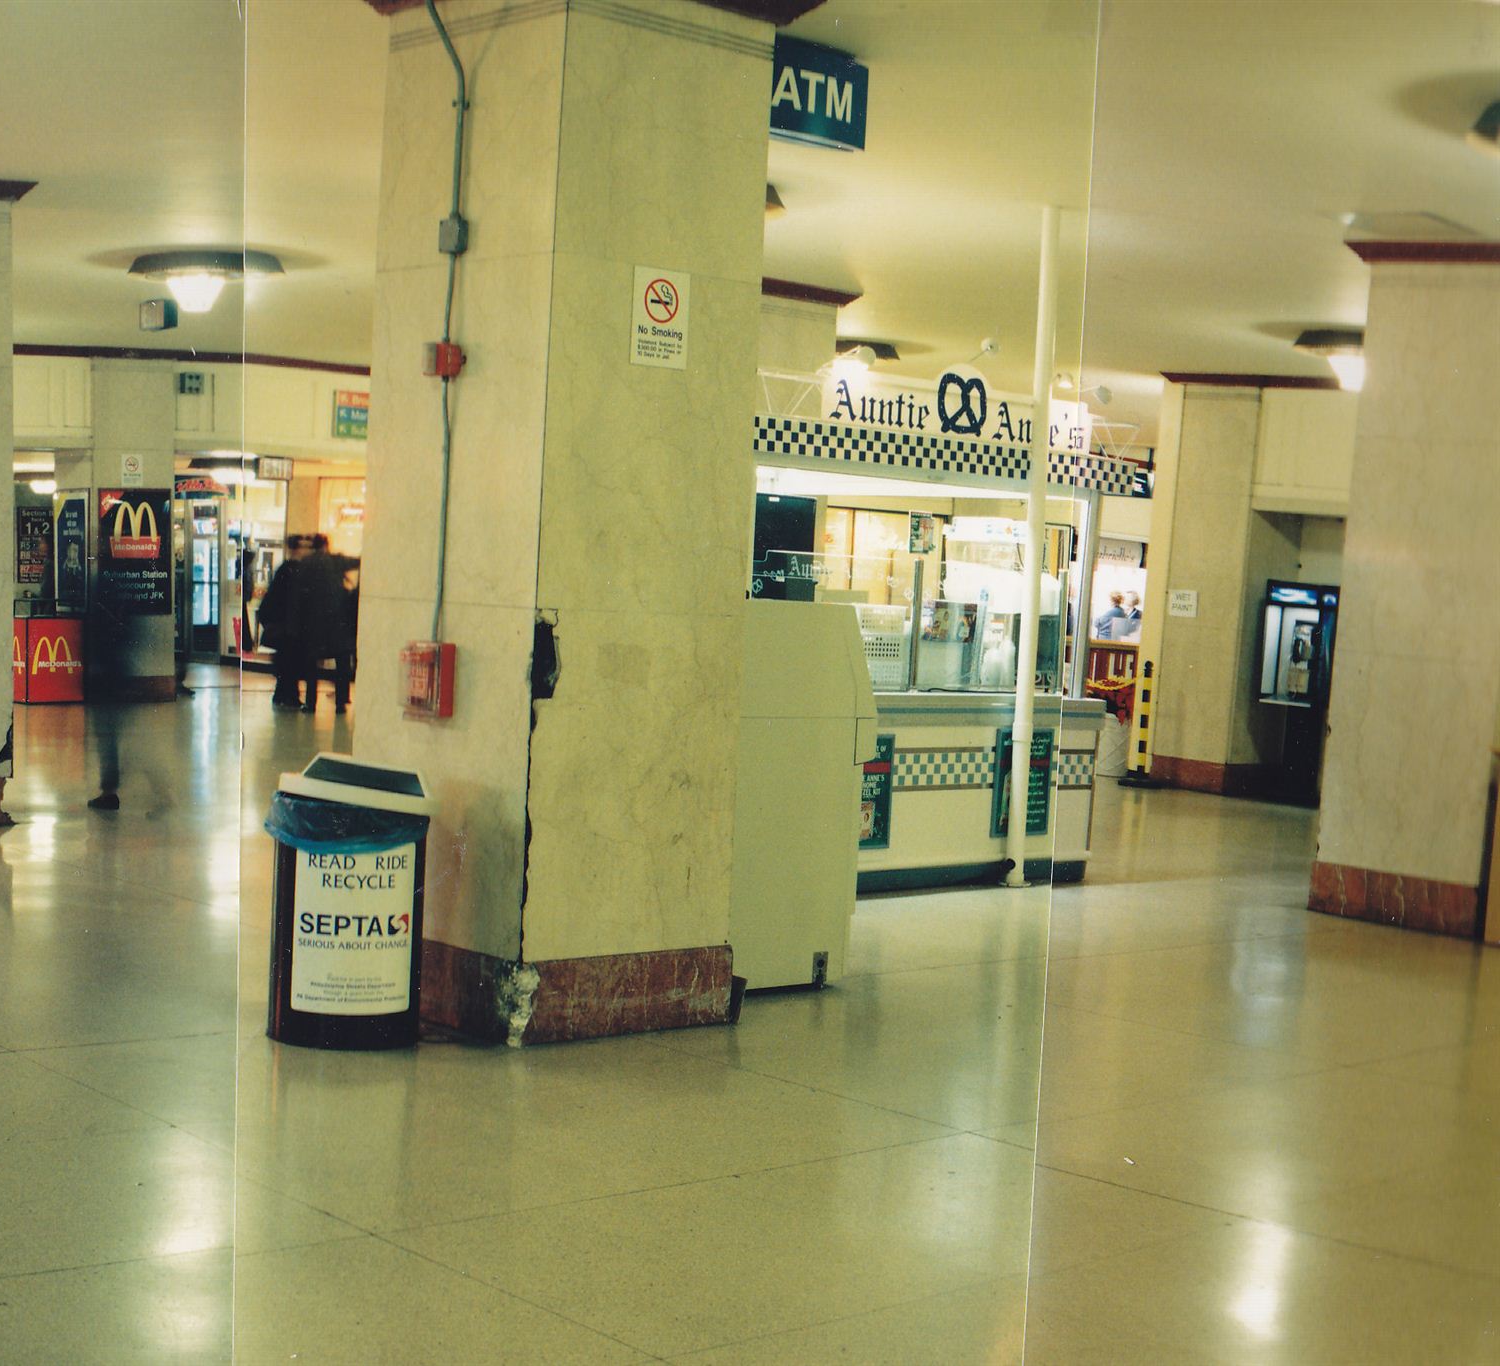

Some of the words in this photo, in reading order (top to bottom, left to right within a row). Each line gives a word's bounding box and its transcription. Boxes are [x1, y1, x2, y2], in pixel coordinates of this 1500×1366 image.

[771, 65, 853, 124] ATM
[637, 325, 648, 335] No
[651, 326, 683, 341] Smoking
[828, 378, 931, 431] Auntie
[991, 401, 1084, 450] Ane's
[25, 522, 32, 535] 1
[42, 522, 50, 535] 2
[114, 543, 157, 551] McDonald's
[142, 570, 168, 579] Station
[149, 591, 165, 600] JFK
[1171, 602, 1194, 612] PAINT
[38, 660, 82, 668] McDonald's
[307, 853, 357, 870] READ
[375, 854, 408, 870] RIDE
[322, 873, 396, 889] RECYCLE
[300, 912, 383, 937] SEPTA
[297, 938, 335, 949] SERIOUS
[338, 941, 371, 951] ABOUT
